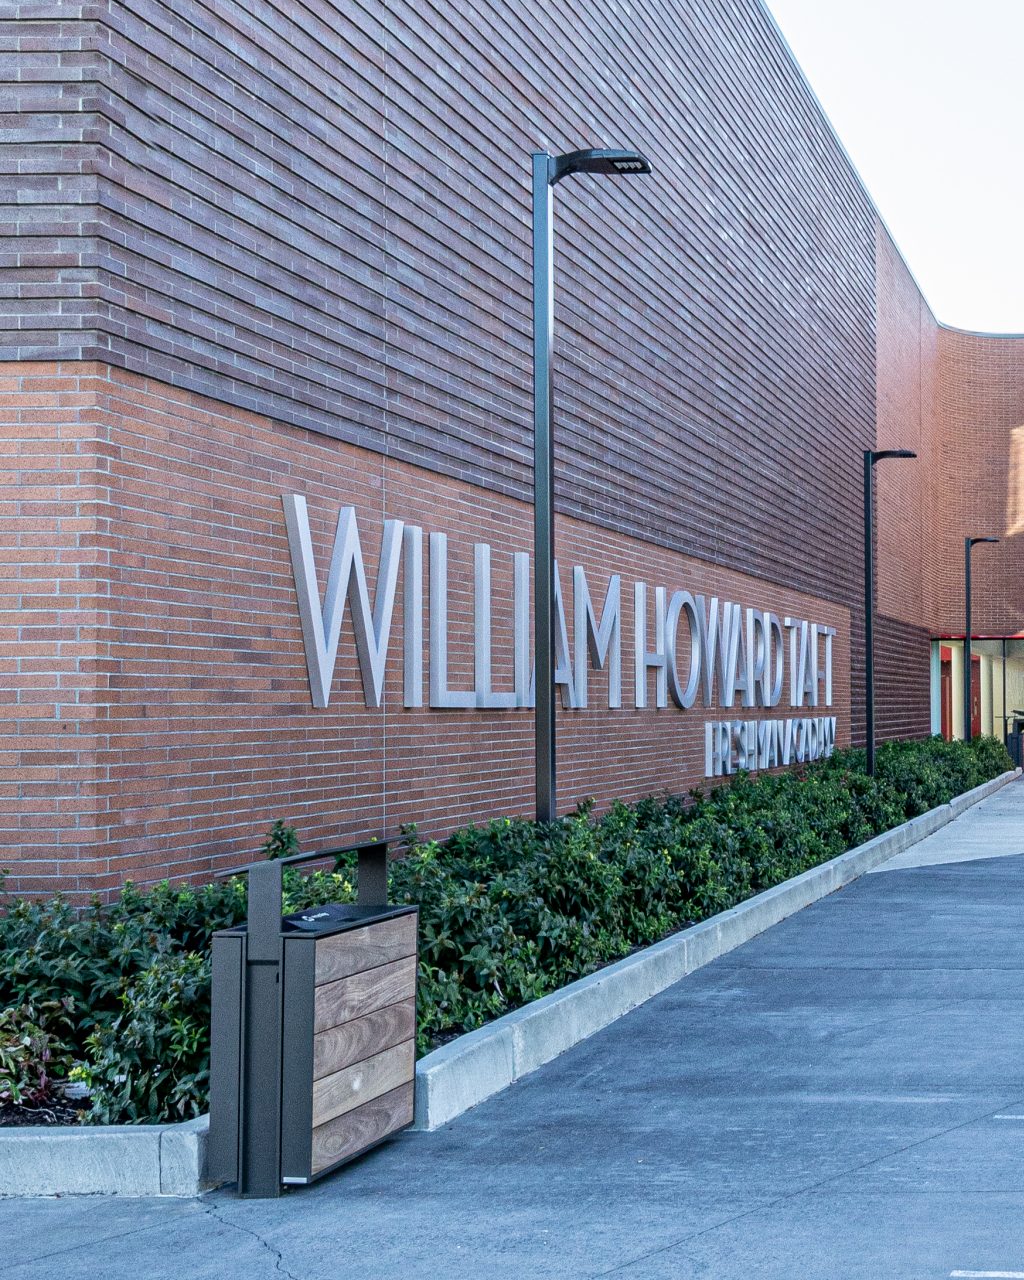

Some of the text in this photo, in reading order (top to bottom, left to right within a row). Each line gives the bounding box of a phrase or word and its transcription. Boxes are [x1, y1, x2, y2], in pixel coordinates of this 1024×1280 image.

[281, 493, 836, 709] WILLIAM HOWARD TAFT
